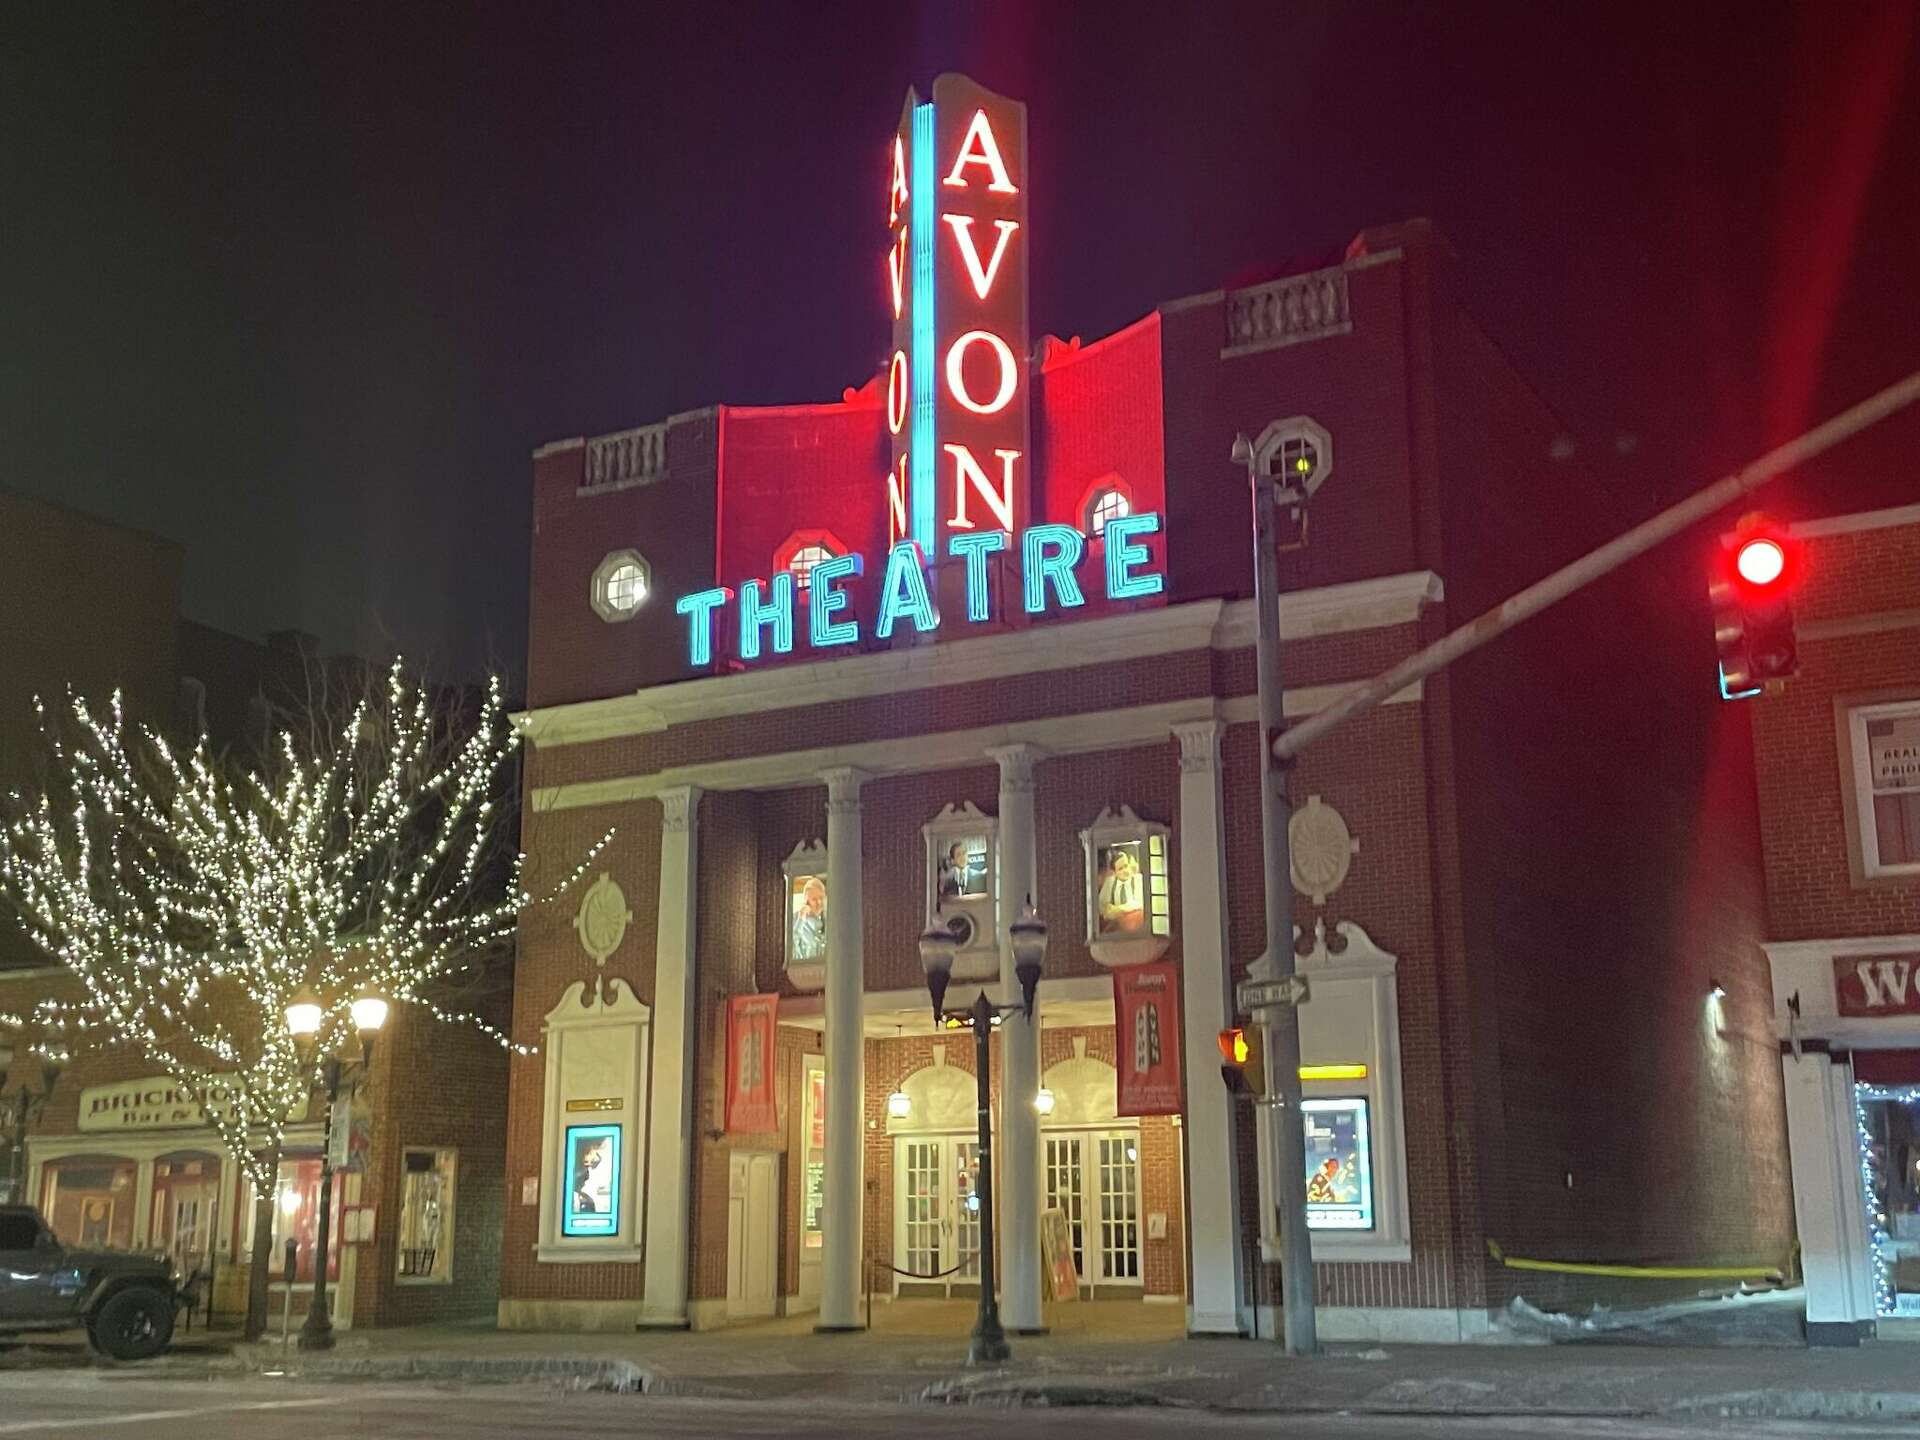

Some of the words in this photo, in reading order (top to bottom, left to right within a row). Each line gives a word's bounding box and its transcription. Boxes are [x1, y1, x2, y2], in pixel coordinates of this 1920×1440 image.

[887, 133, 908, 549] AVON
[943, 109, 1022, 536] AVON
[677, 512, 1164, 665] THEATRE
[1857, 959, 1920, 1007] W
